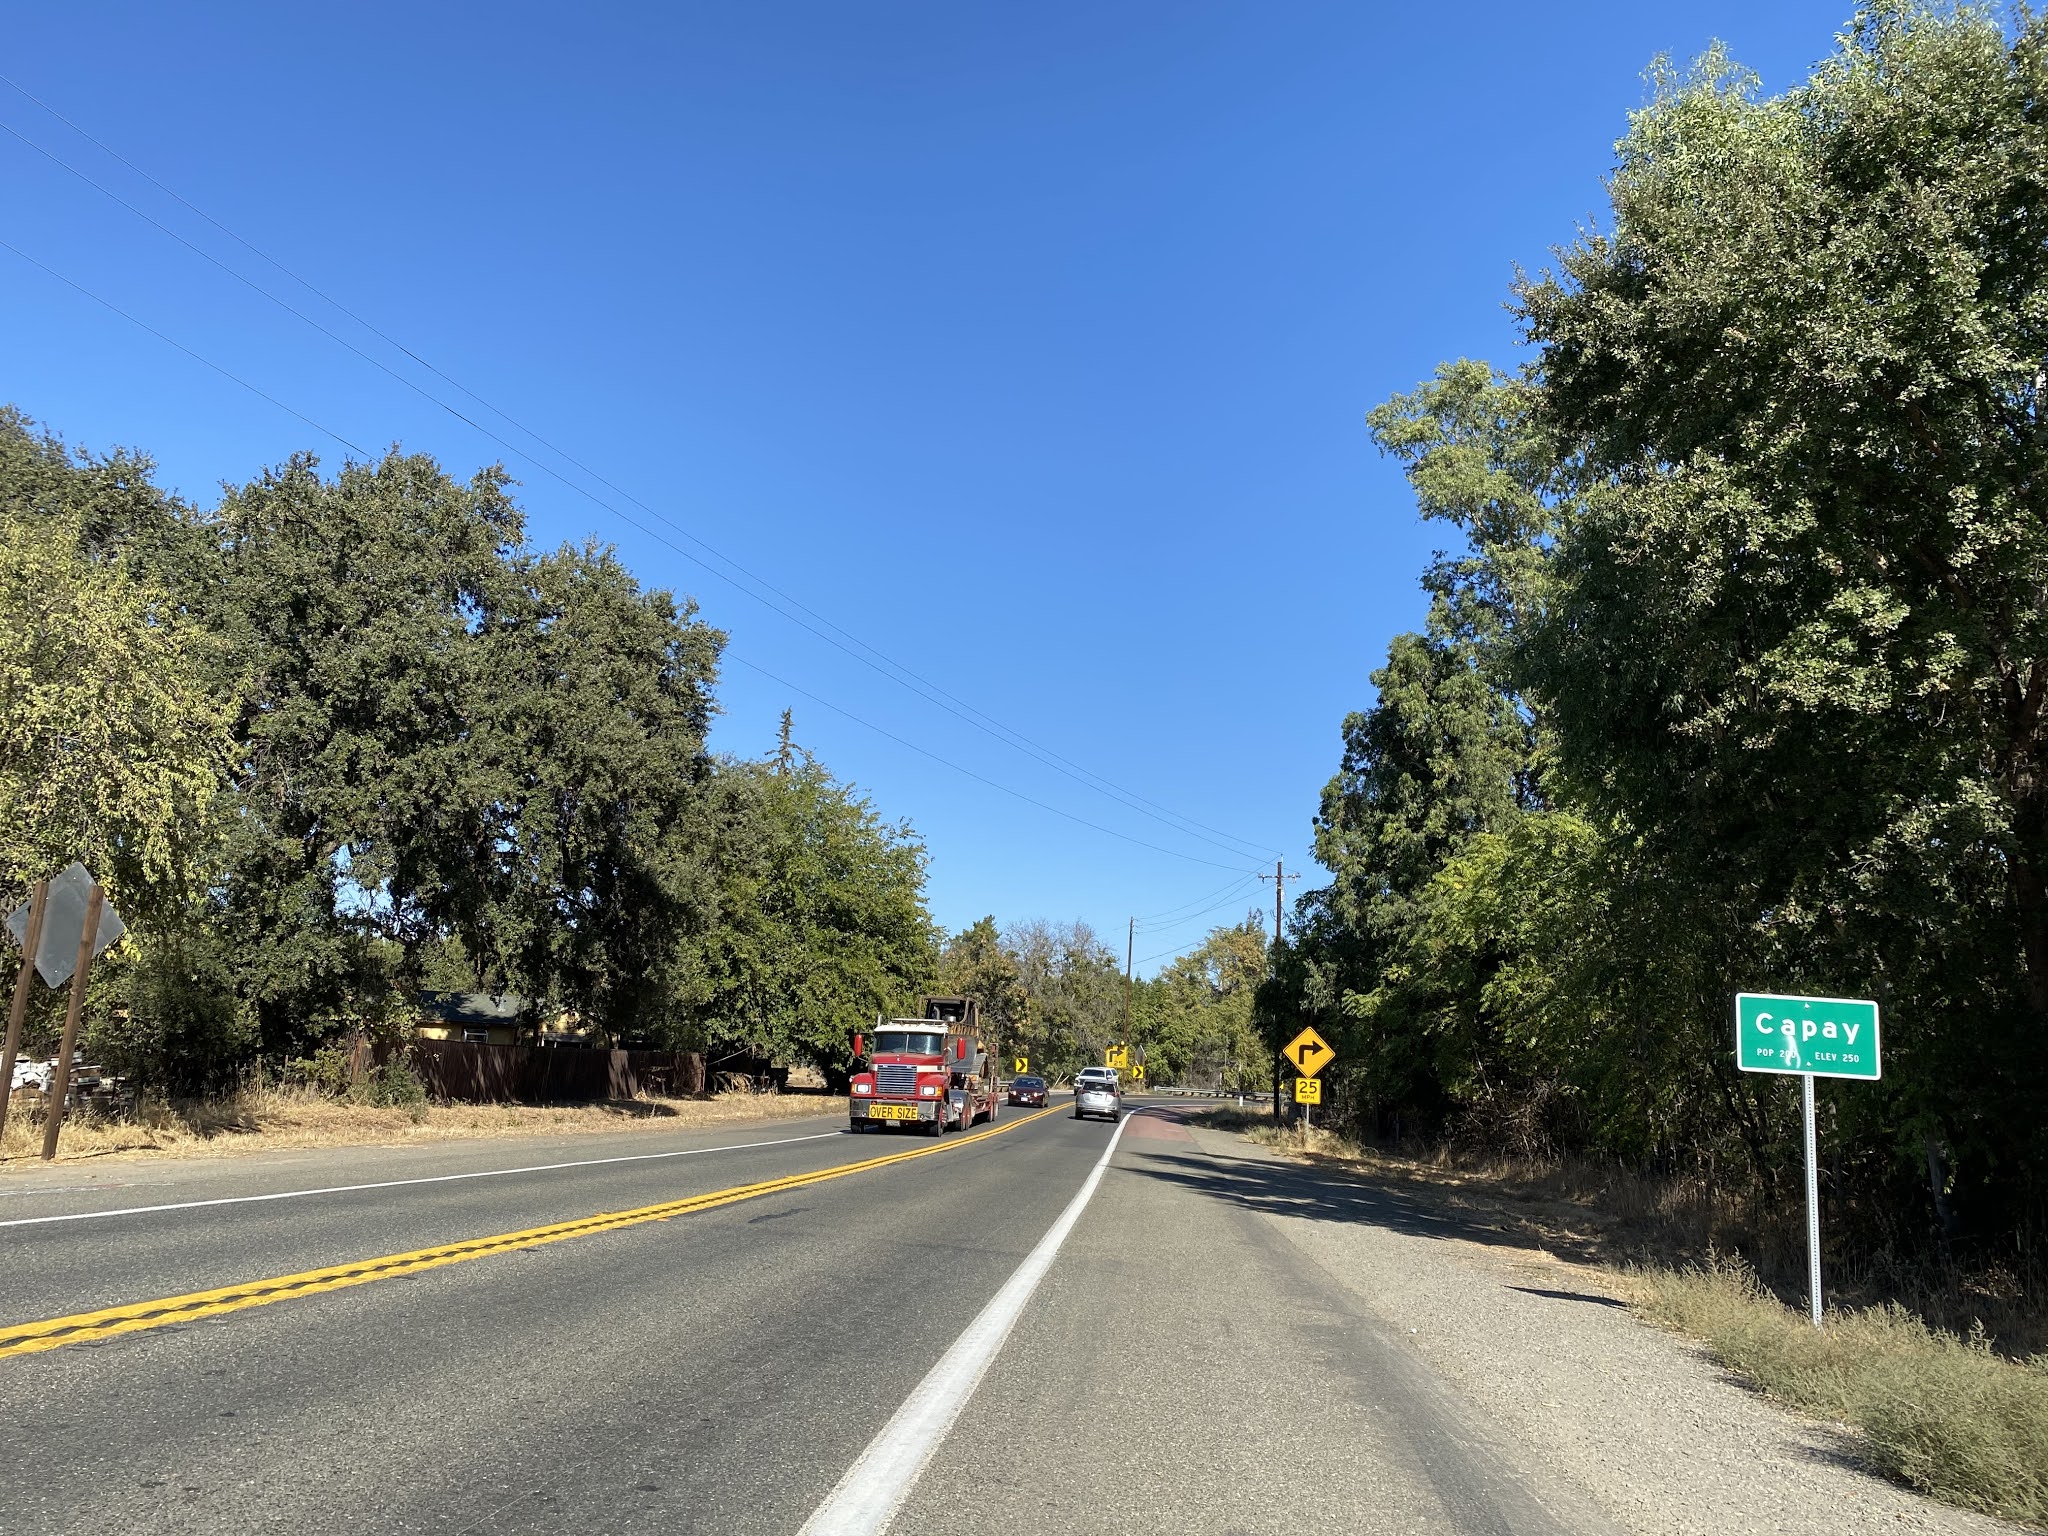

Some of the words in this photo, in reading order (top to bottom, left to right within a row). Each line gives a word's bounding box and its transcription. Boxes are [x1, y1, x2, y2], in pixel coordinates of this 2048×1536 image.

[1755, 1012, 1860, 1045] Capay
[1756, 1048, 1774, 1057] POP
[1815, 1052, 1837, 1062] ELEV
[1842, 1054, 1860, 1063] 250
[1299, 1081, 1317, 1094] 25
[870, 1106, 893, 1118] OVER
[897, 1107, 917, 1119] SIZE
